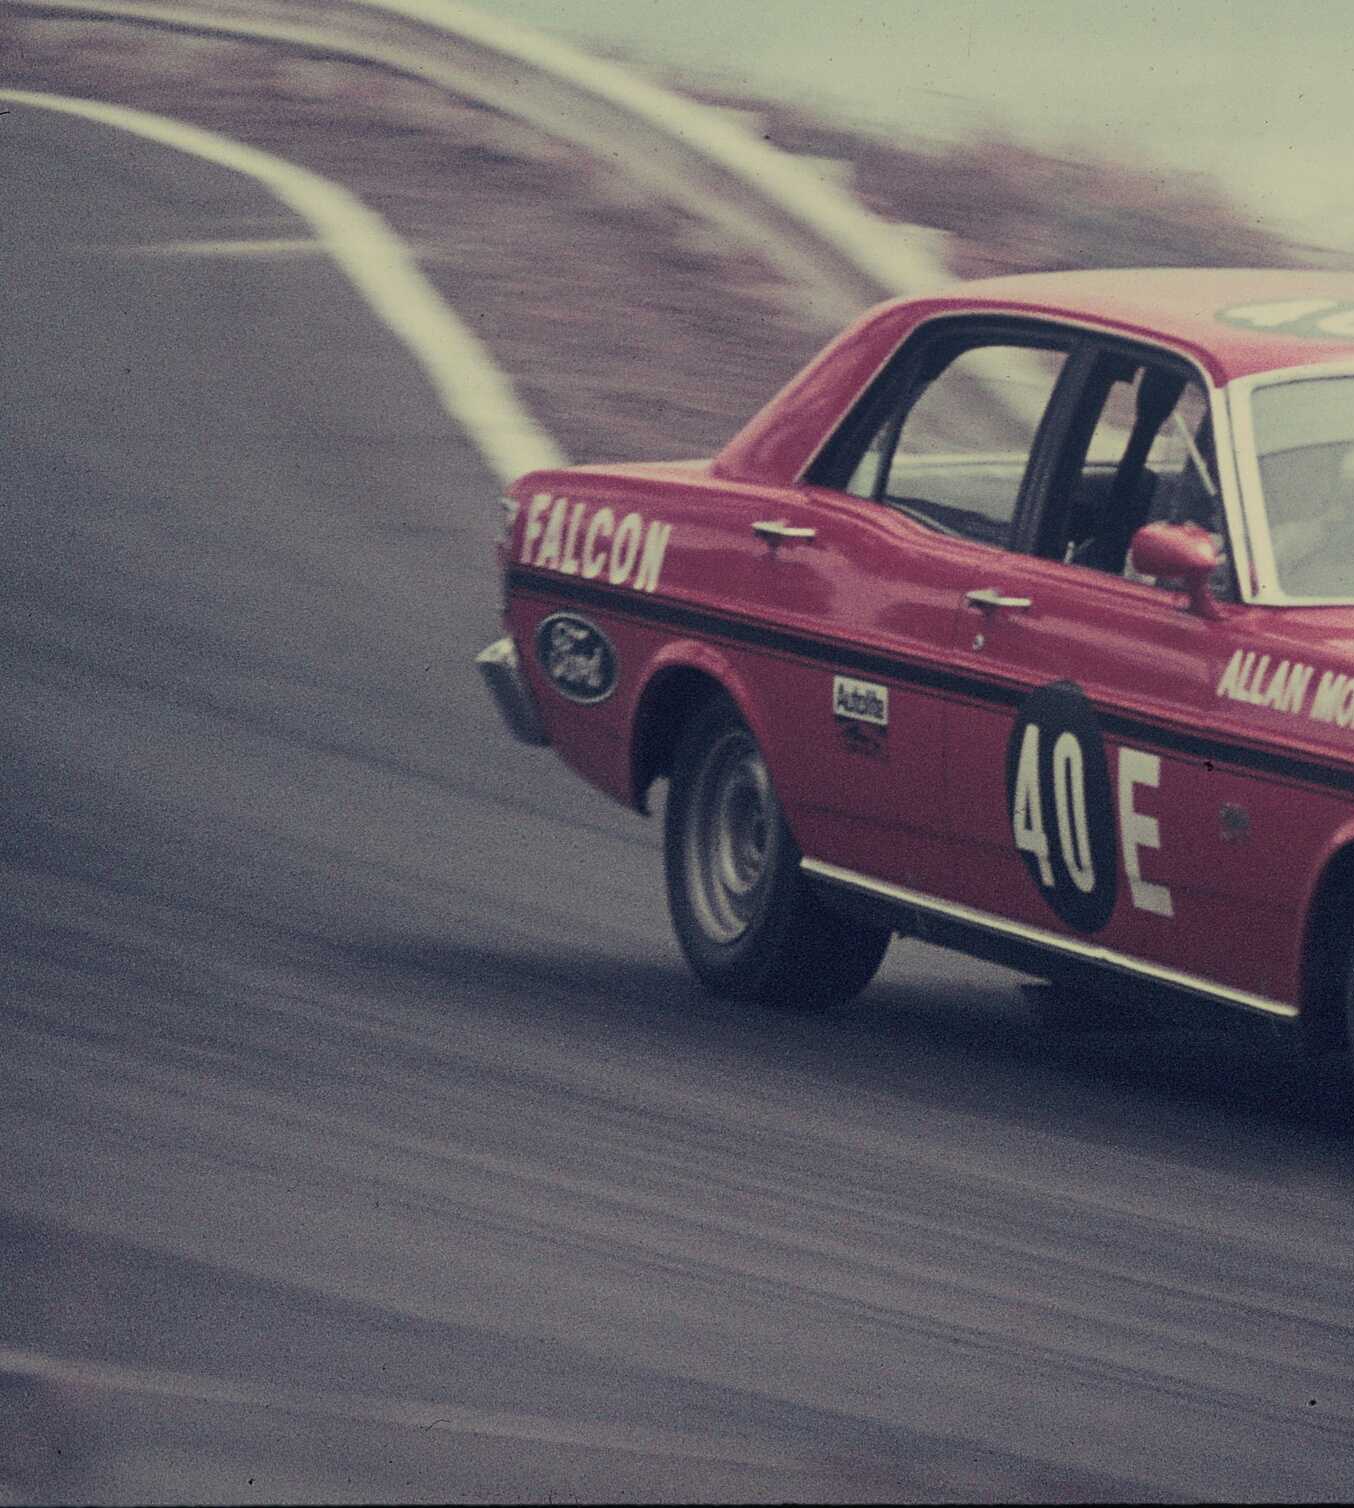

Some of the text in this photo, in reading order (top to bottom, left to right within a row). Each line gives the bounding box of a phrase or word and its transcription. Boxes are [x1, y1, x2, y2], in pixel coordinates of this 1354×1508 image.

[520, 494, 672, 592] FALCON
[1216, 649, 1314, 715] ALLAN
[1013, 723, 1174, 917] 40 E
